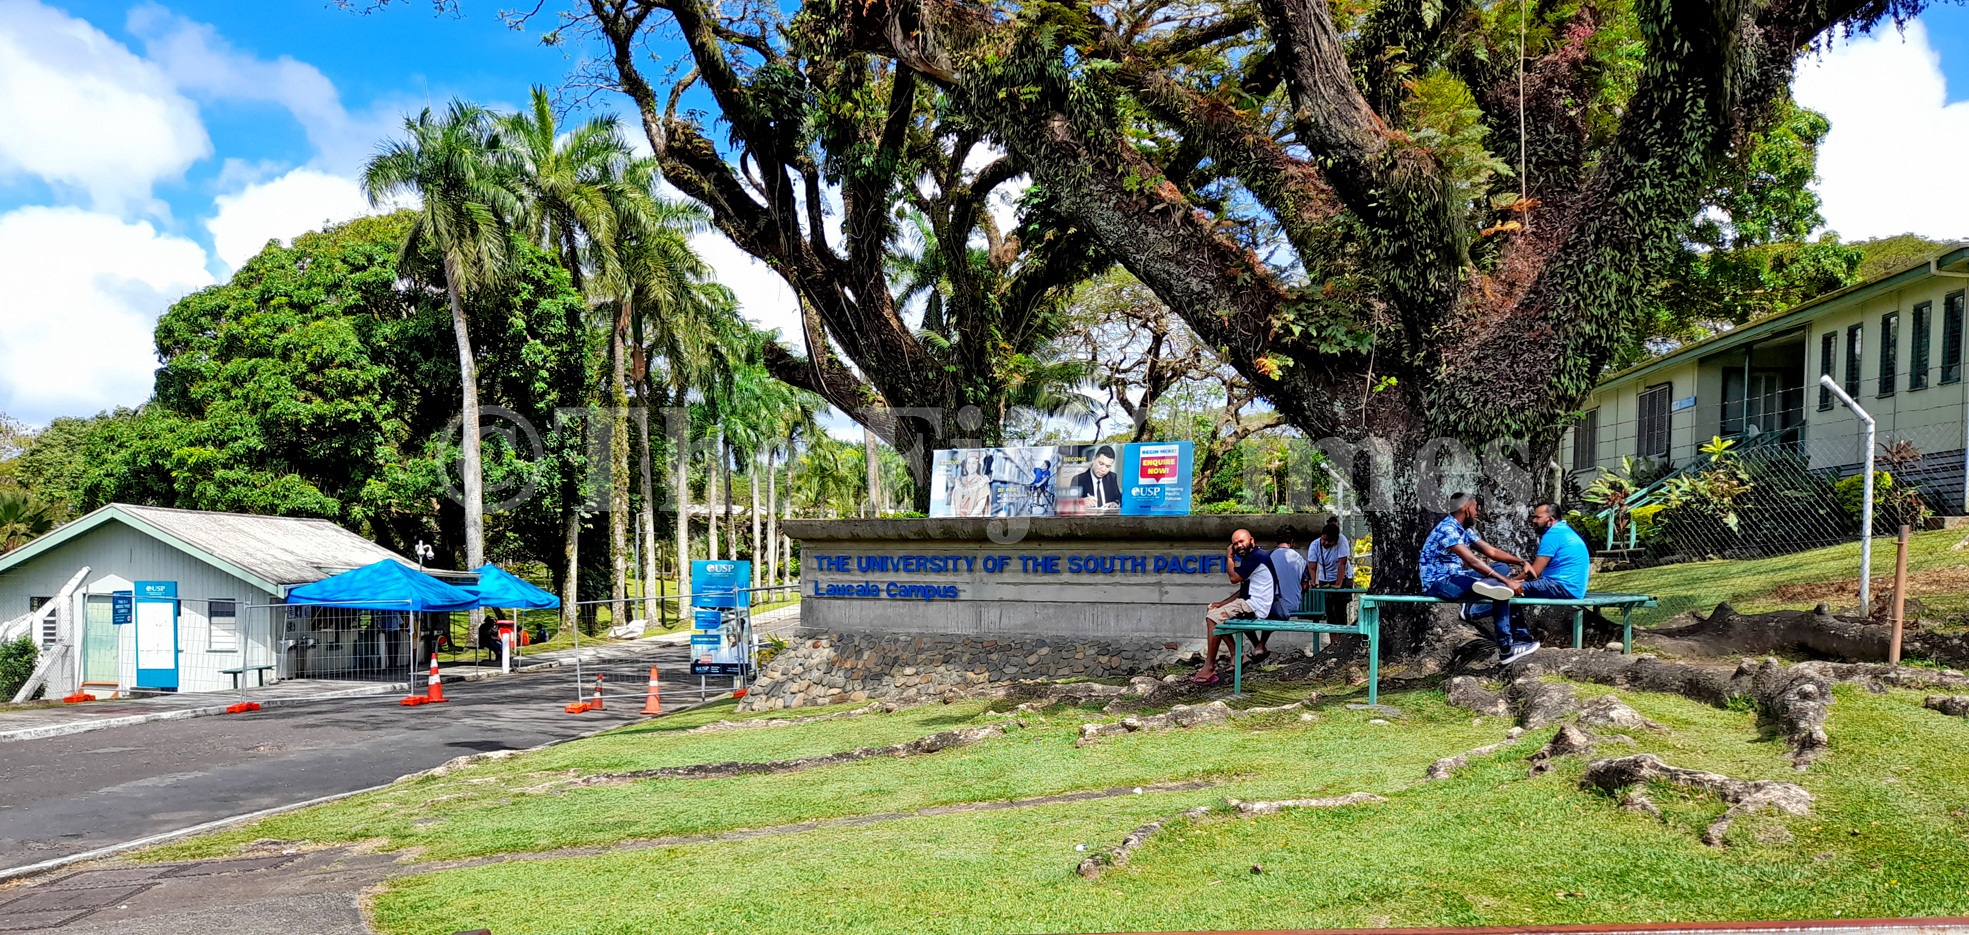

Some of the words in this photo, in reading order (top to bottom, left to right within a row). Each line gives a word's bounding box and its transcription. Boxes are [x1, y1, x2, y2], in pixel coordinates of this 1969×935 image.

[1142, 458, 1175, 466] ENQUIRE
[1147, 467, 1169, 475] NOW!
[1140, 487, 1161, 496] USP
[714, 564, 735, 573] USP
[814, 555, 851, 573] THE
[857, 555, 976, 573] UNIVERSITY
[982, 555, 1011, 573] OF
[1018, 555, 1060, 573] THE
[1067, 555, 1146, 574] SOUTH
[814, 580, 880, 597] Laucala
[886, 581, 958, 602] Campus
